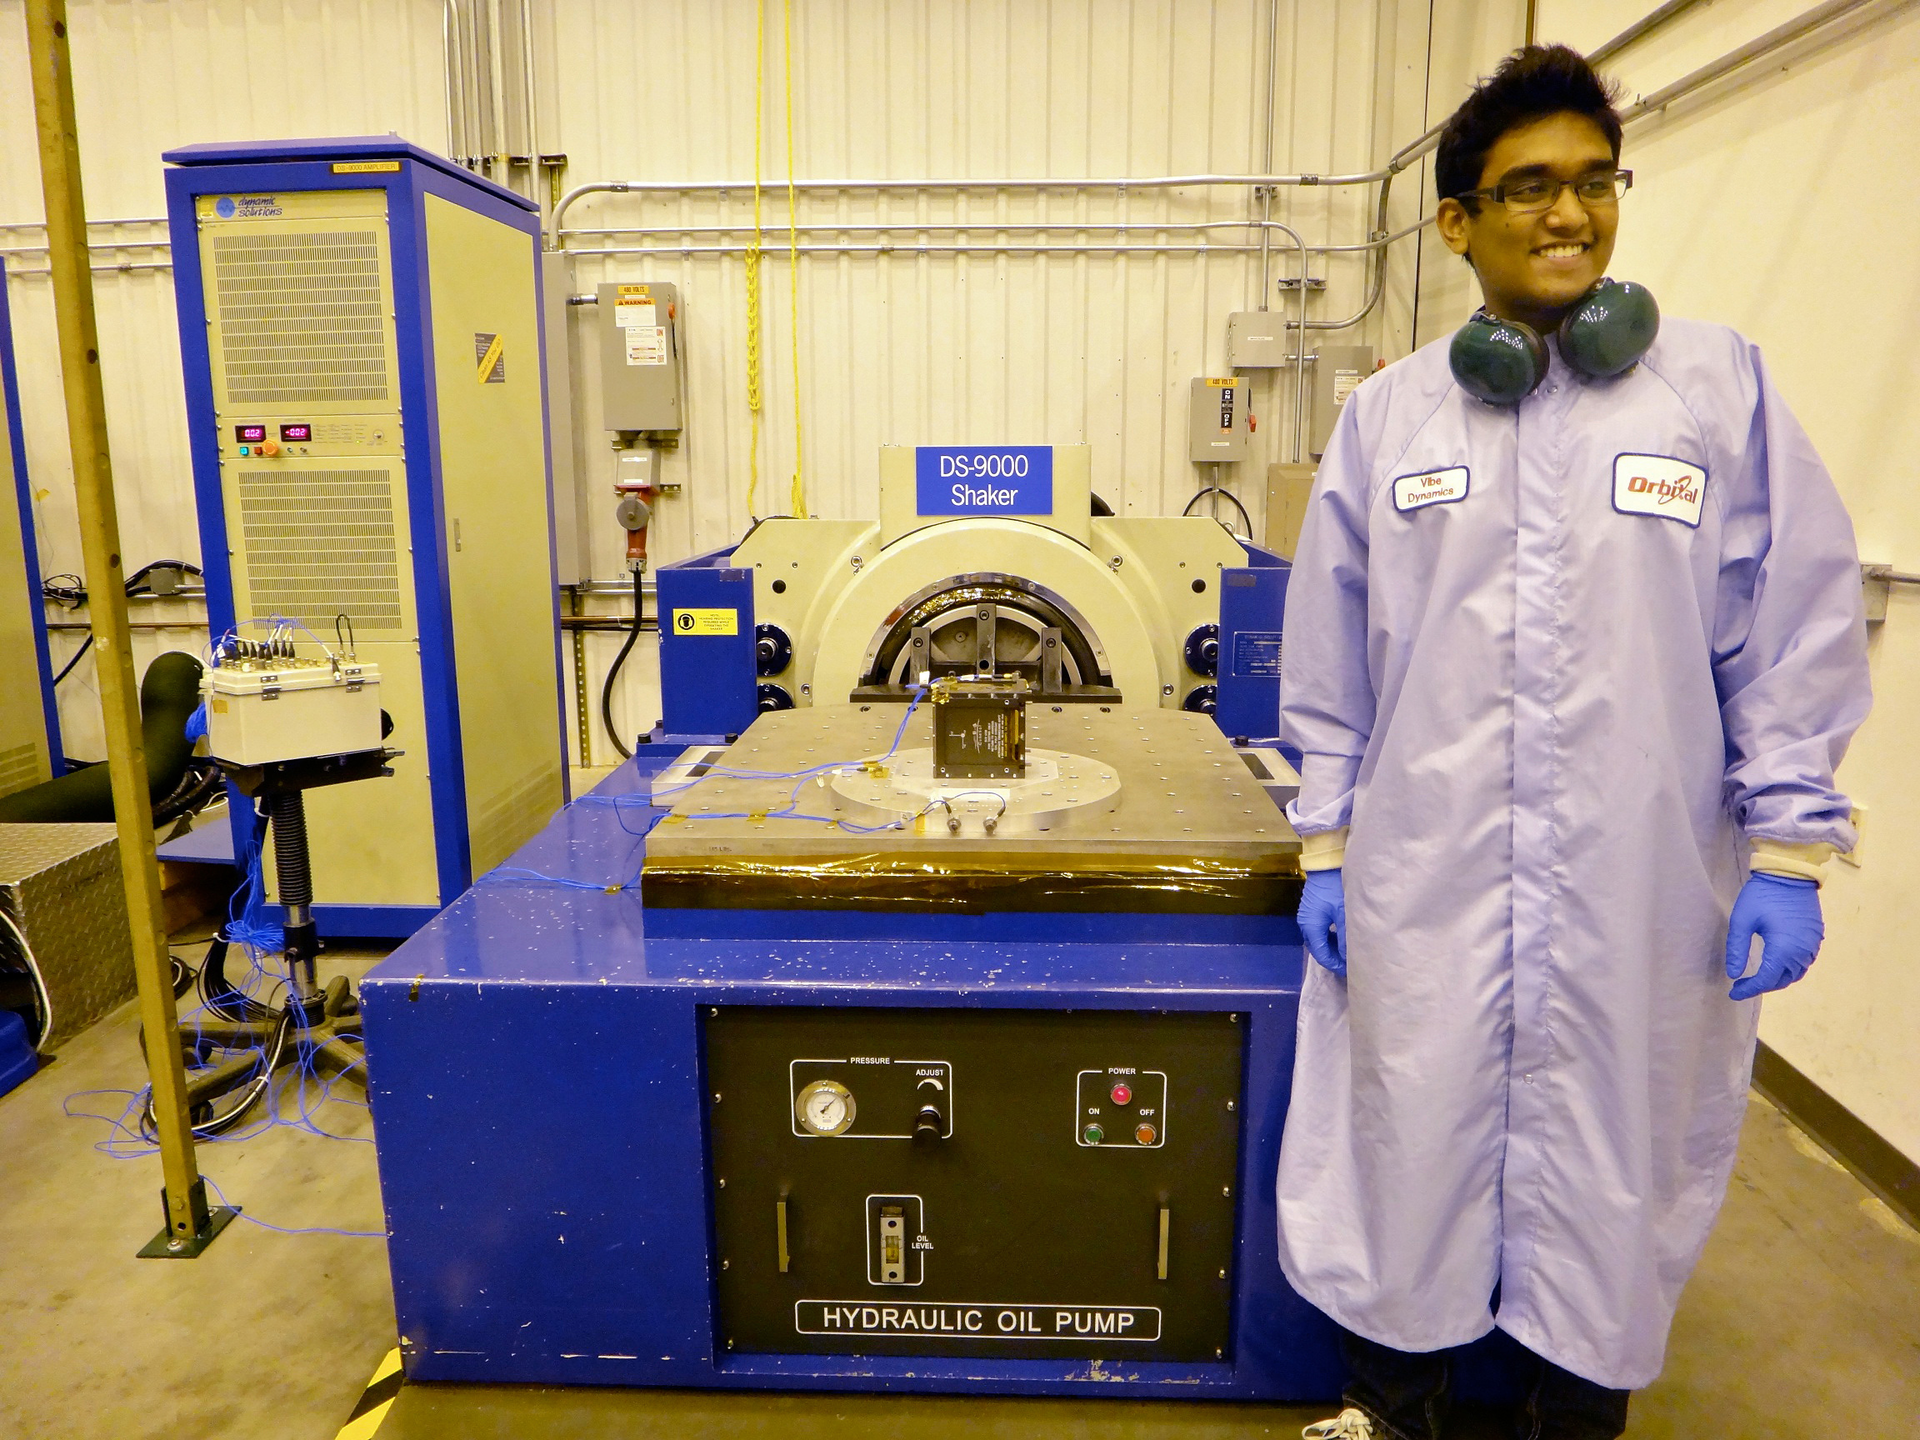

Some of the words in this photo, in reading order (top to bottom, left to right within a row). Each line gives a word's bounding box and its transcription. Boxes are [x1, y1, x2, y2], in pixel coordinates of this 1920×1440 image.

[238, 196, 275, 209] dynamic
[238, 207, 282, 217] solutions
[1224, 389, 1231, 399] ON
[940, 454, 1028, 477] DS-9000
[1420, 476, 1442, 488] Vibe
[951, 483, 1018, 506] Shaker
[1407, 487, 1454, 503] Dynamics
[1628, 475, 1698, 504] Orbital
[1108, 1067, 1136, 1075] POWER
[1088, 1107, 1100, 1115] ON
[1139, 1108, 1155, 1116] OFF
[911, 1242, 934, 1250] LEVEL
[822, 1307, 983, 1331] HYDRAULIC
[997, 1310, 1042, 1332] OIL
[1055, 1312, 1135, 1334] PUMP
